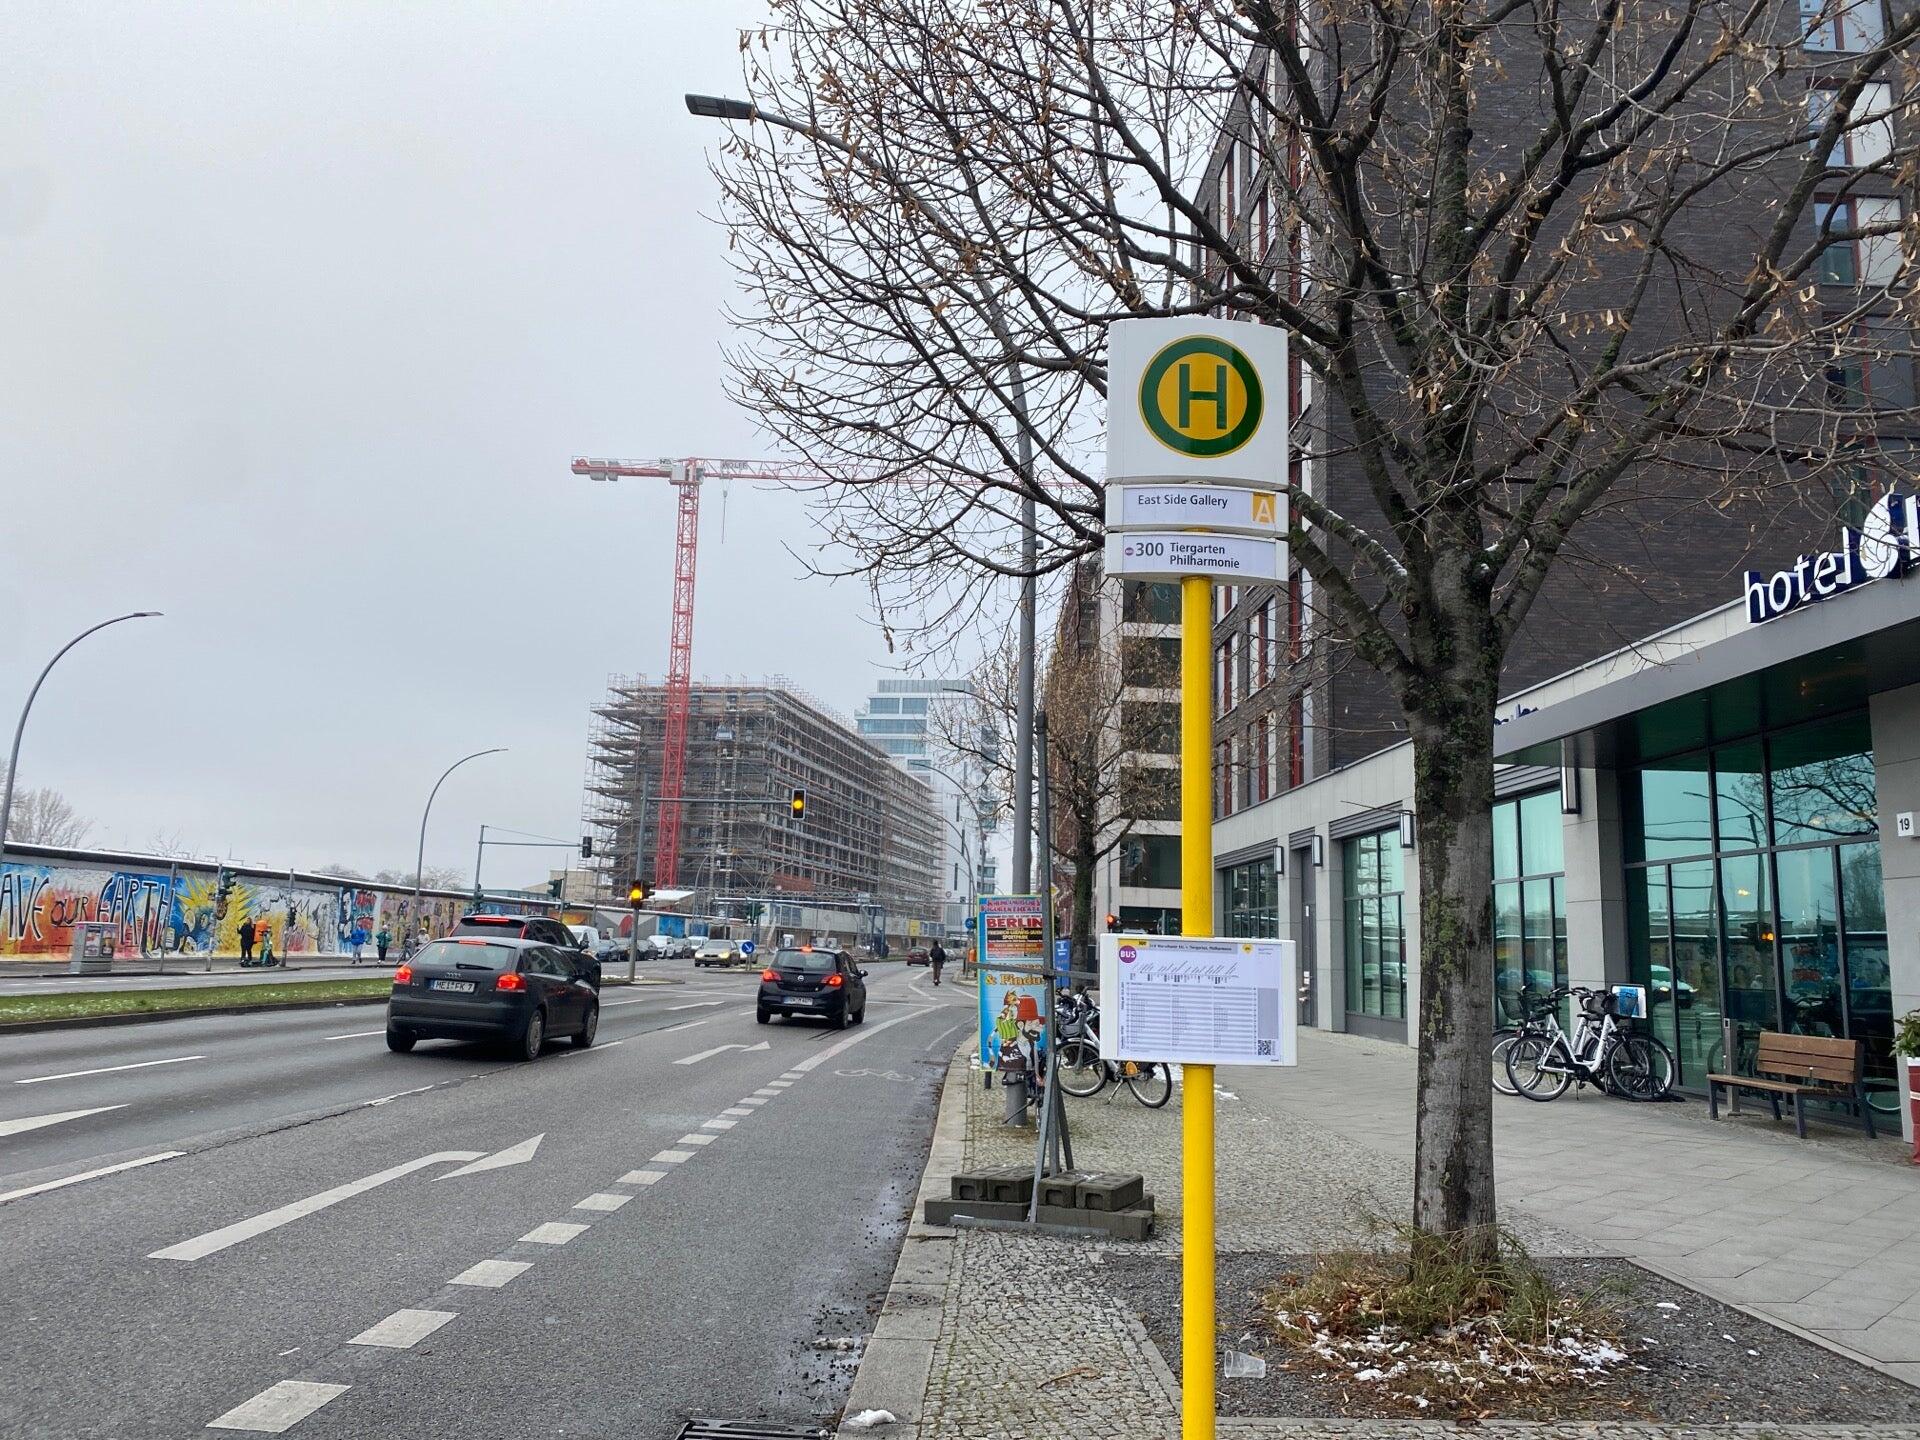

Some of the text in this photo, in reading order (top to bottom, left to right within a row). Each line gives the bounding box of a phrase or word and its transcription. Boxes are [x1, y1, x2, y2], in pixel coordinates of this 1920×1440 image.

[1178, 363, 1228, 430] H
[1138, 494, 1228, 509] East Side Gallery
[1255, 499, 1273, 524] A
[1136, 543, 1164, 557] 300
[1170, 542, 1225, 556] Tiergarten
[1169, 555, 1240, 569] Philharmonie
[1743, 526, 1853, 624] hotel
[1899, 817, 1911, 831] 19
[986, 918, 1043, 928] BERLIN
[1120, 950, 1136, 958] BUS
[1000, 973, 1043, 986] Findu
